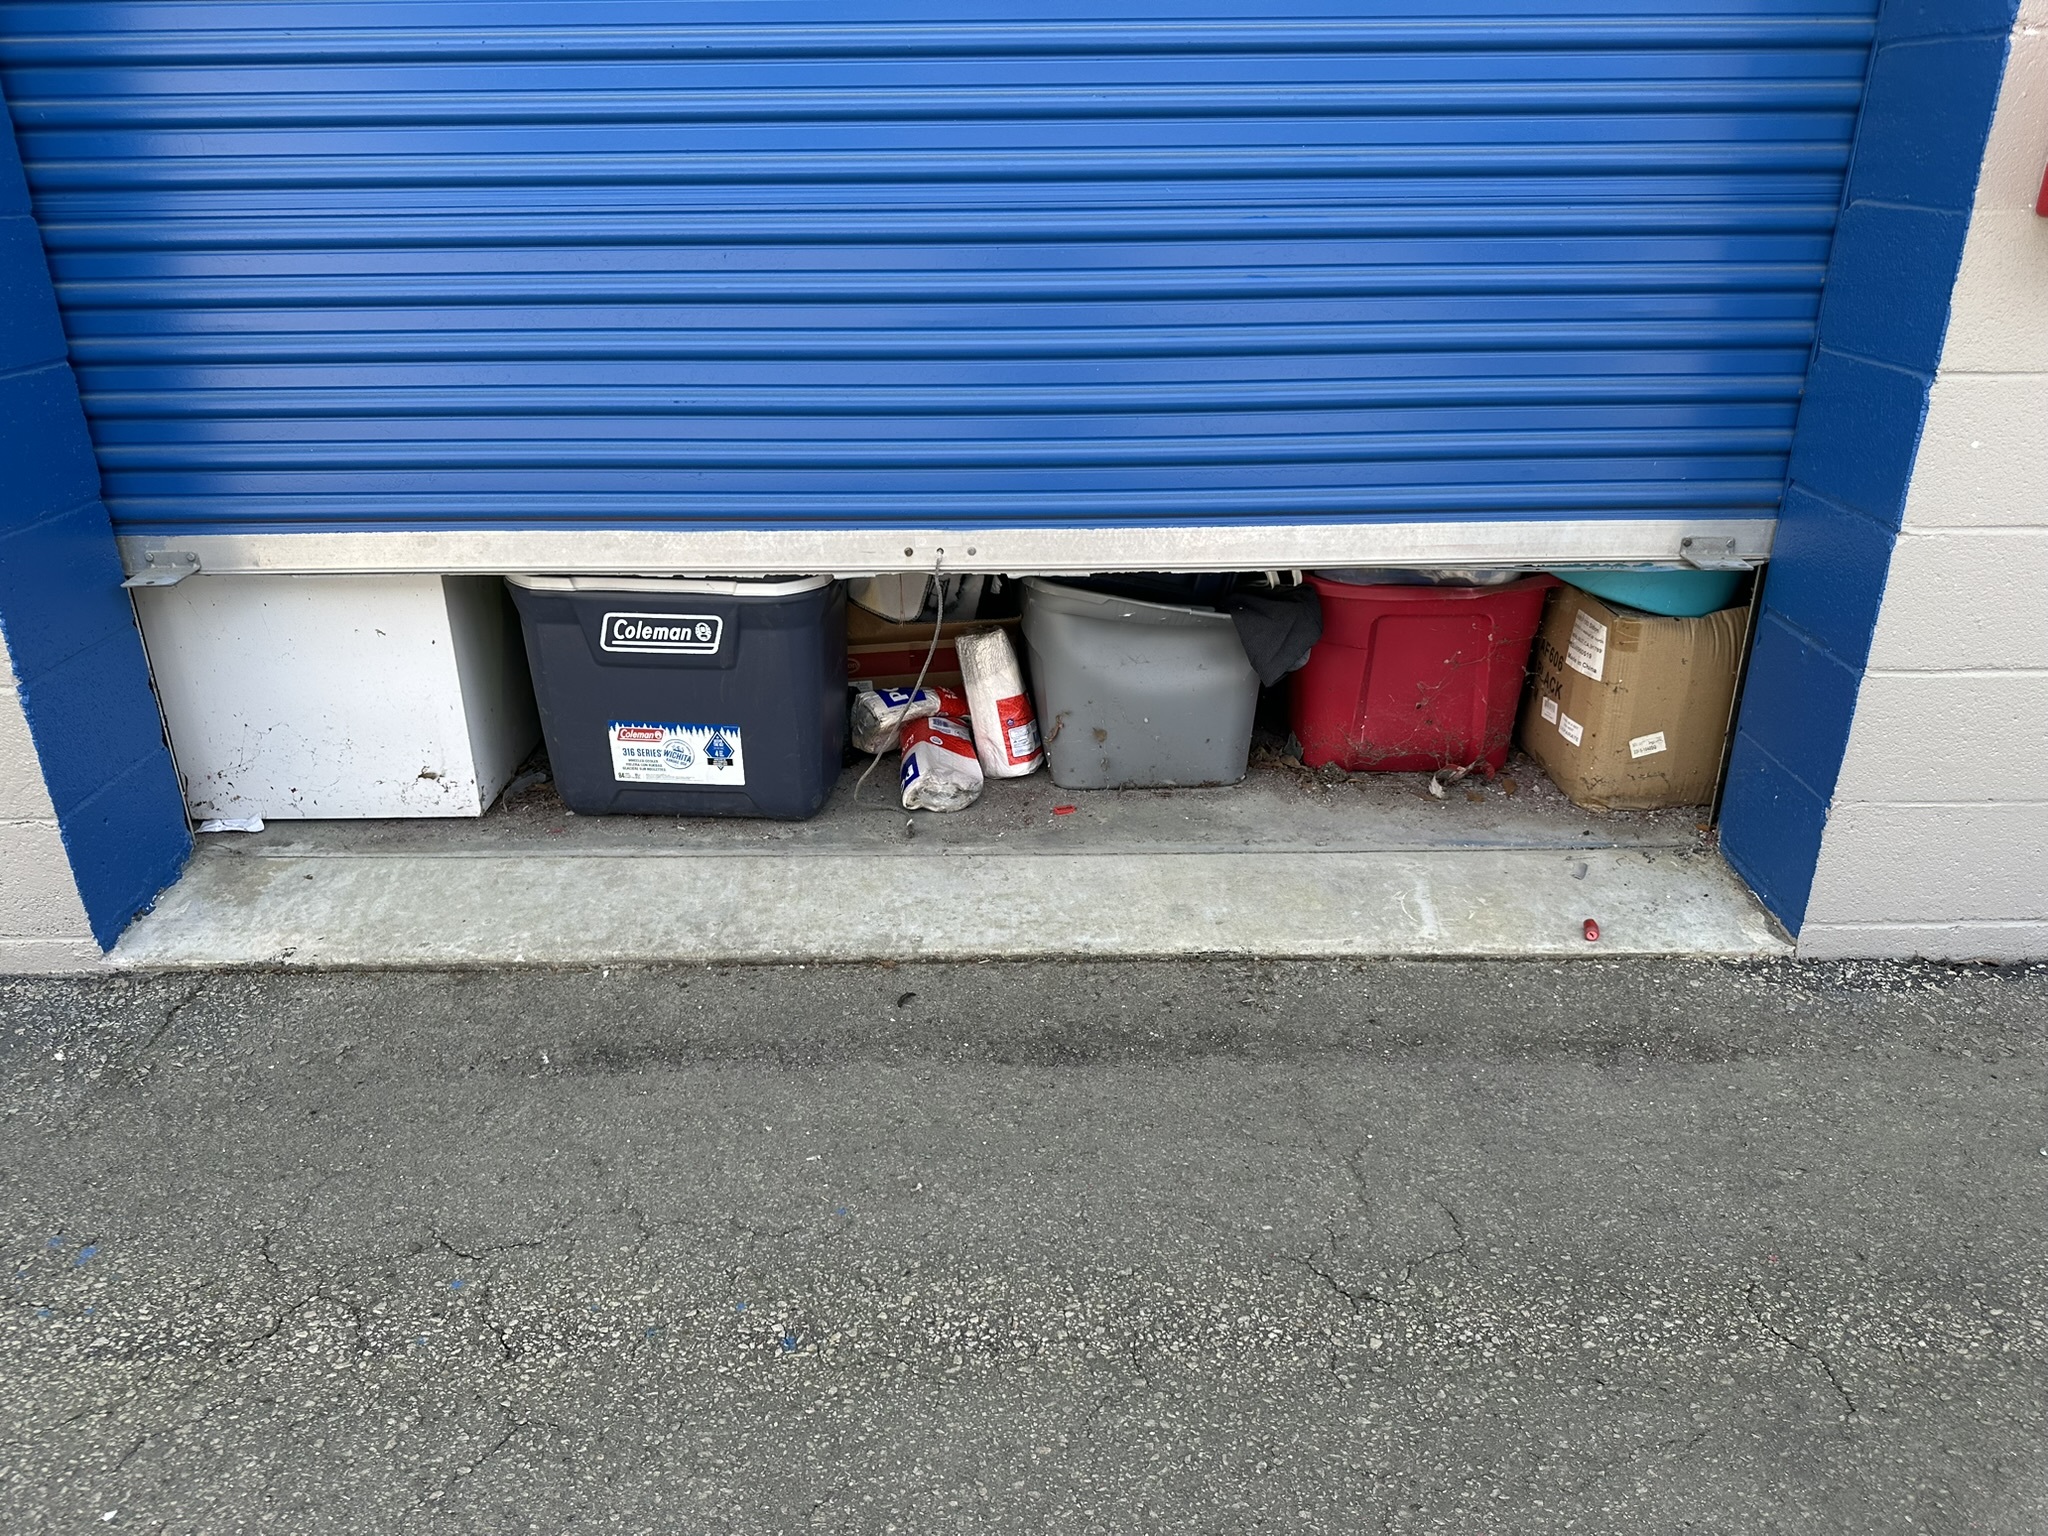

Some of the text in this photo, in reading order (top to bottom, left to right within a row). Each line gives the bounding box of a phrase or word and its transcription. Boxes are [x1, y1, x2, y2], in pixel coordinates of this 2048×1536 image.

[613, 619, 692, 641] Coleman
[619, 728, 655, 739] Coleman
[622, 747, 662, 758] 316 SERIES
[663, 749, 692, 763] WICHITA
